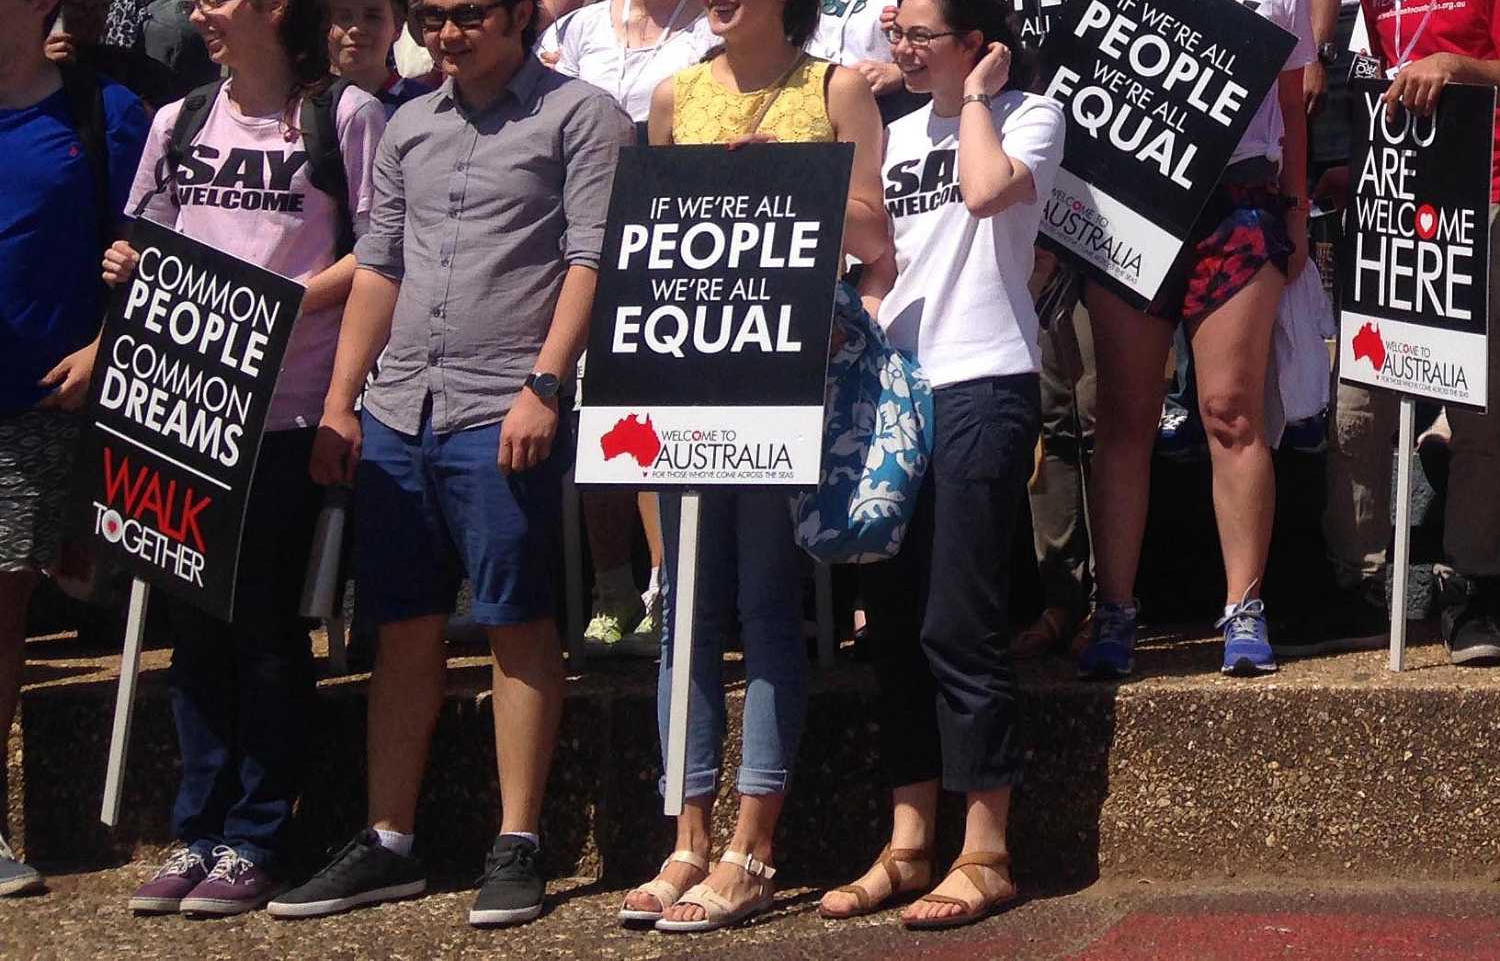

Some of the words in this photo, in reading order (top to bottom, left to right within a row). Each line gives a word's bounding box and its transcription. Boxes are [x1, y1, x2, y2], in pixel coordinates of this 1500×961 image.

[1073, 0, 1249, 127] PEOPLE
[1142, 3, 1204, 54] WE'RE
[1200, 43, 1237, 76] ALL
[1093, 60, 1154, 112] WE'RE
[1152, 100, 1187, 134] ALL
[1364, 92, 1437, 148] YOU
[1045, 65, 1198, 190] EQUAL
[176, 144, 309, 191] SAY
[884, 149, 959, 199] SA
[1356, 146, 1417, 200] ARE
[650, 197, 671, 219] IF
[677, 196, 750, 219] WE'RE
[755, 195, 796, 218] ALL
[1356, 196, 1475, 245] WELCOME
[617, 221, 821, 270] PEOPLE
[138, 247, 280, 333] COMMON
[652, 278, 723, 301] WE'RE
[729, 278, 771, 301] ALL
[1354, 233, 1474, 320] HERE
[123, 279, 269, 378] PEOPLE
[611, 304, 802, 358] EQUAL
[112, 335, 253, 425] COMMON
[1382, 353, 1468, 390] AUSTRALIA
[99, 366, 244, 467] DREAMS
[661, 430, 718, 441] WELCOME
[721, 430, 737, 441] TO
[654, 443, 793, 470] AUSTRALIA
[103, 447, 211, 553] WALK
[93, 501, 204, 588] TOGETHER
